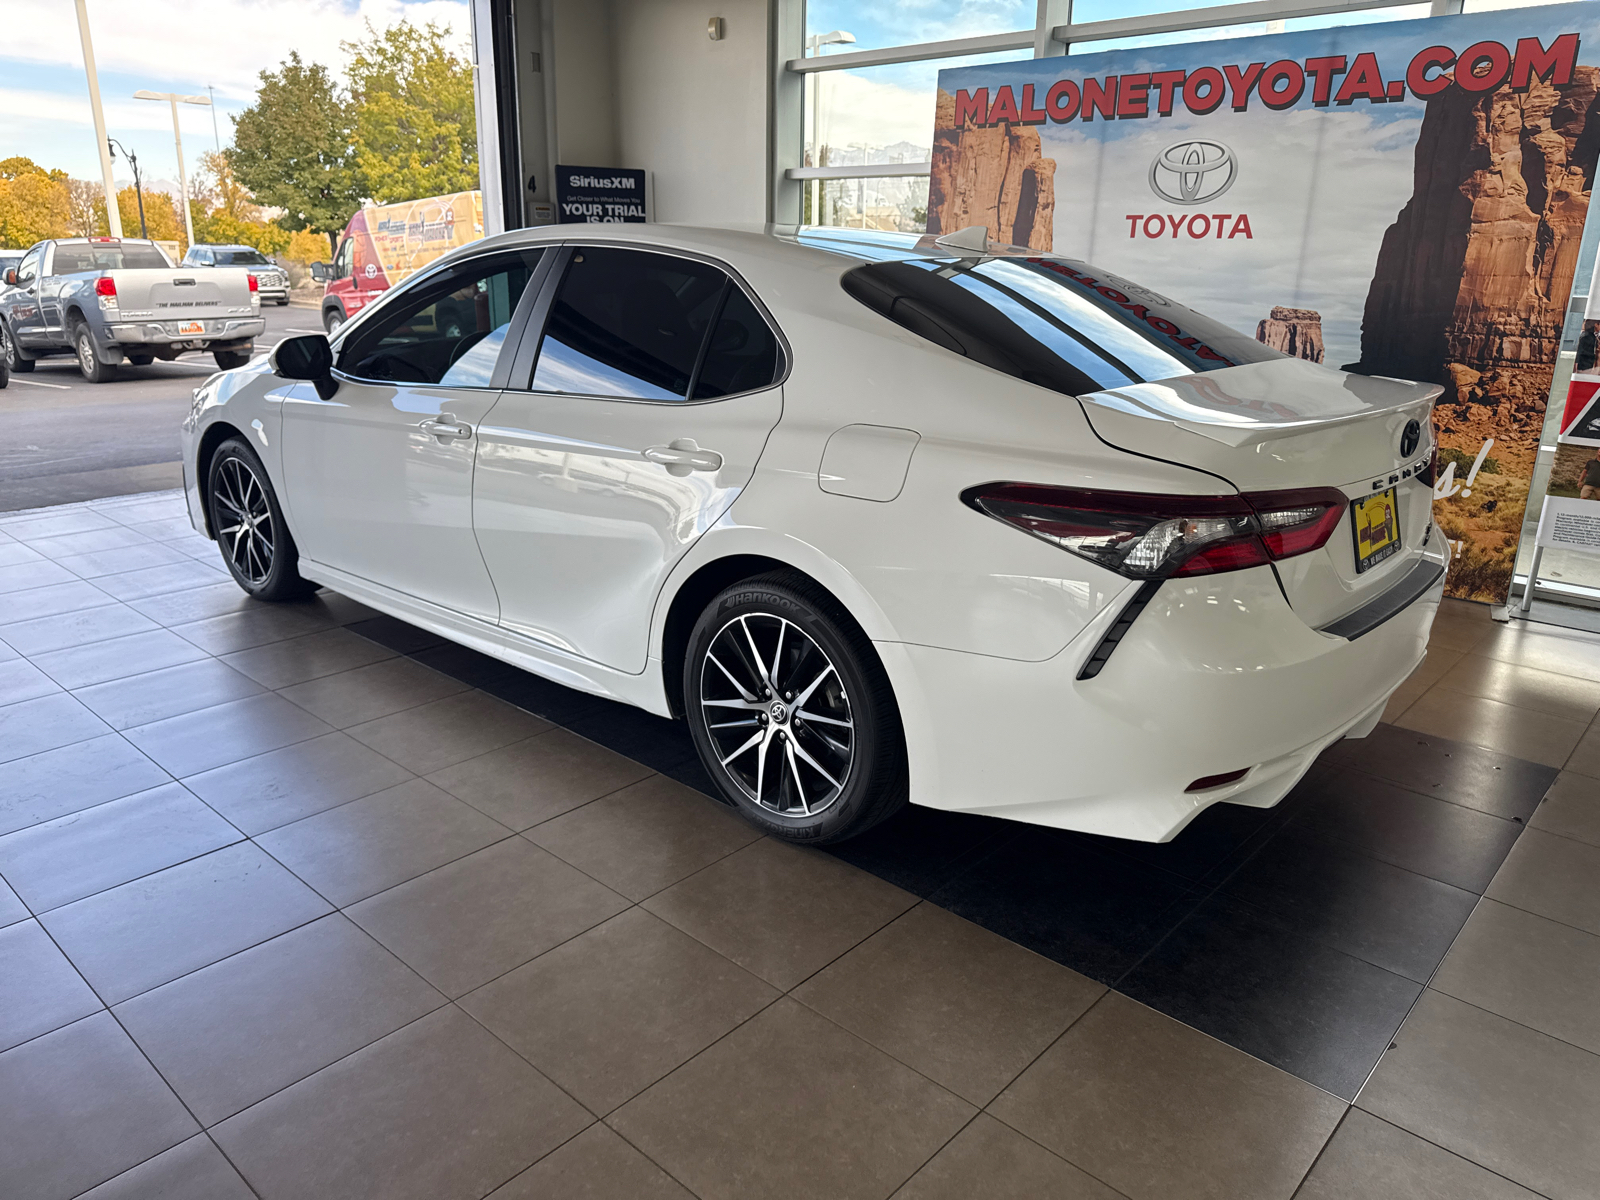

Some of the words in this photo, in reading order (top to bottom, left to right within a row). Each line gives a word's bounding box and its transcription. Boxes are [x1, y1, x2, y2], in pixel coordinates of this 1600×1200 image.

[955, 33, 1580, 127] MALONETOYOTA.COM
[528, 175, 537, 194] 4
[569, 175, 635, 190] SiriusXM
[562, 203, 603, 216] YOUR
[605, 204, 646, 217] TRIAL
[1126, 213, 1254, 240] TOYOTA
[1372, 457, 1430, 491] CAMRY
